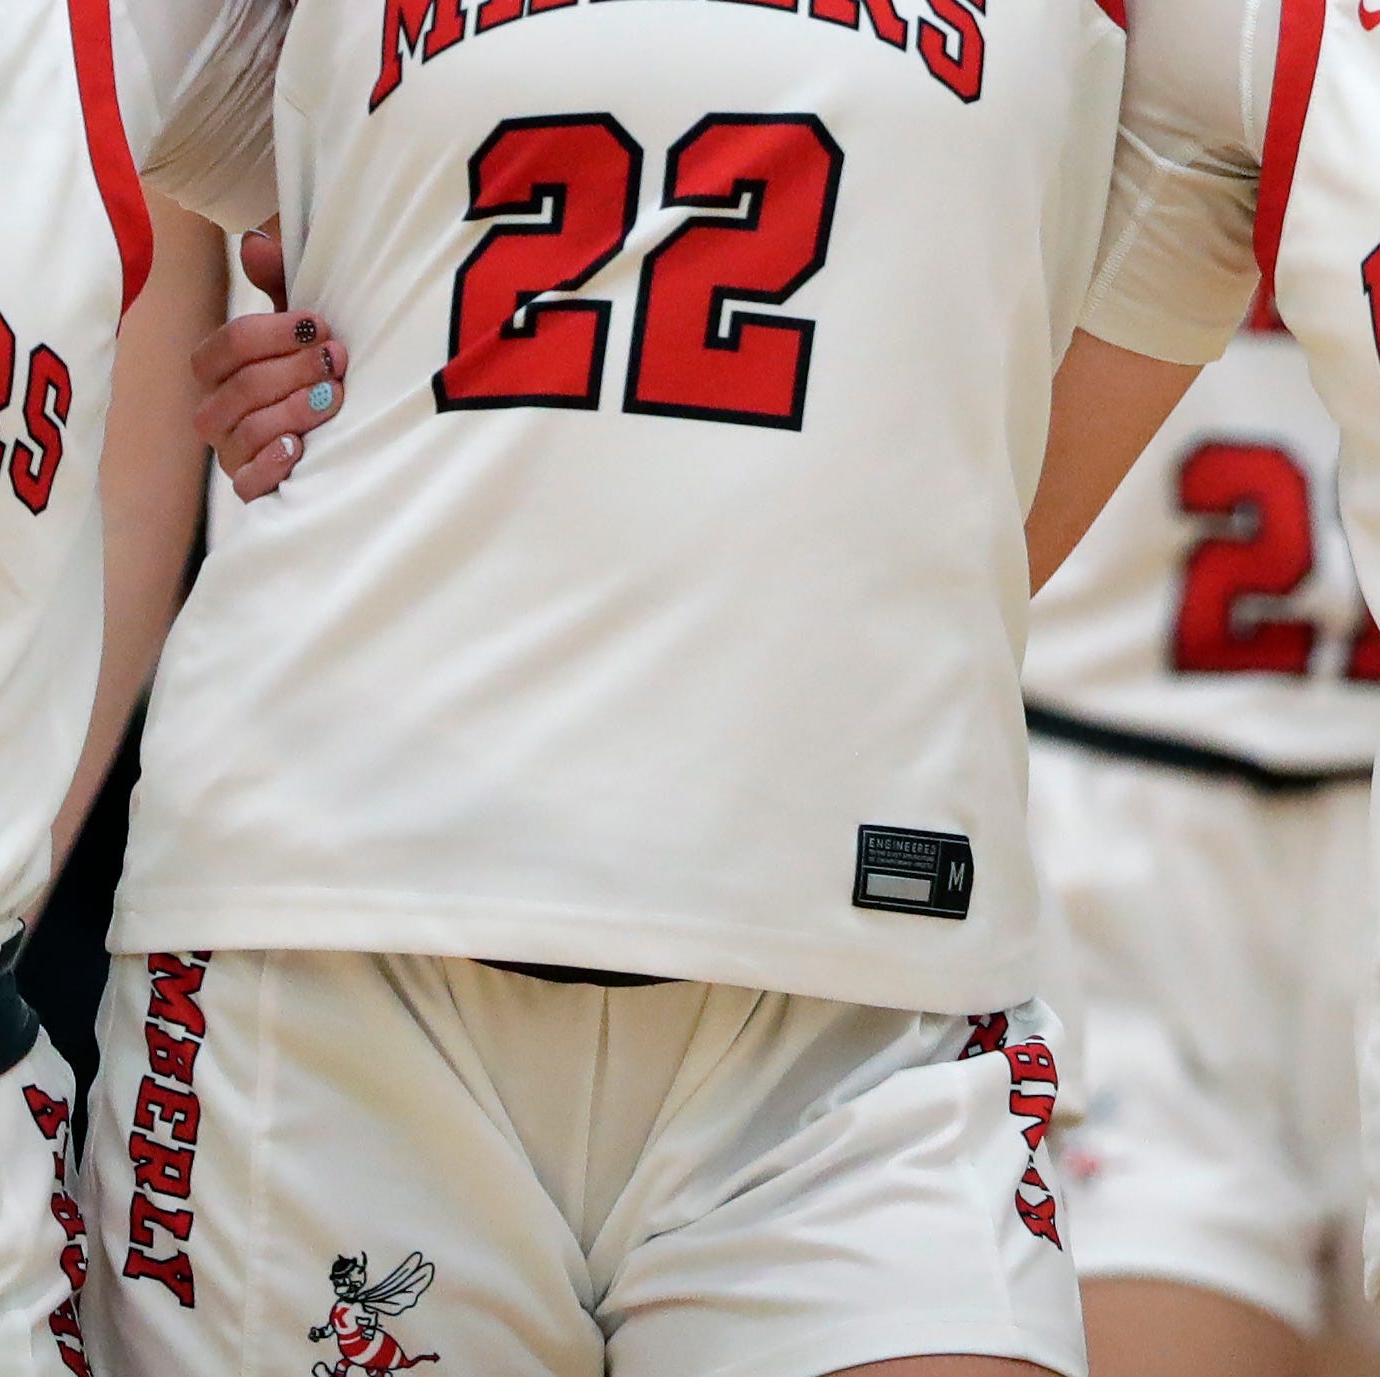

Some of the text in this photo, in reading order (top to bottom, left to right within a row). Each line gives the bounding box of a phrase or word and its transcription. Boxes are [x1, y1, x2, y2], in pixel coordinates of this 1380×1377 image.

[431, 111, 845, 432] 22
[948, 860, 966, 892] M
[123, 950, 212, 1309] MBERLY
